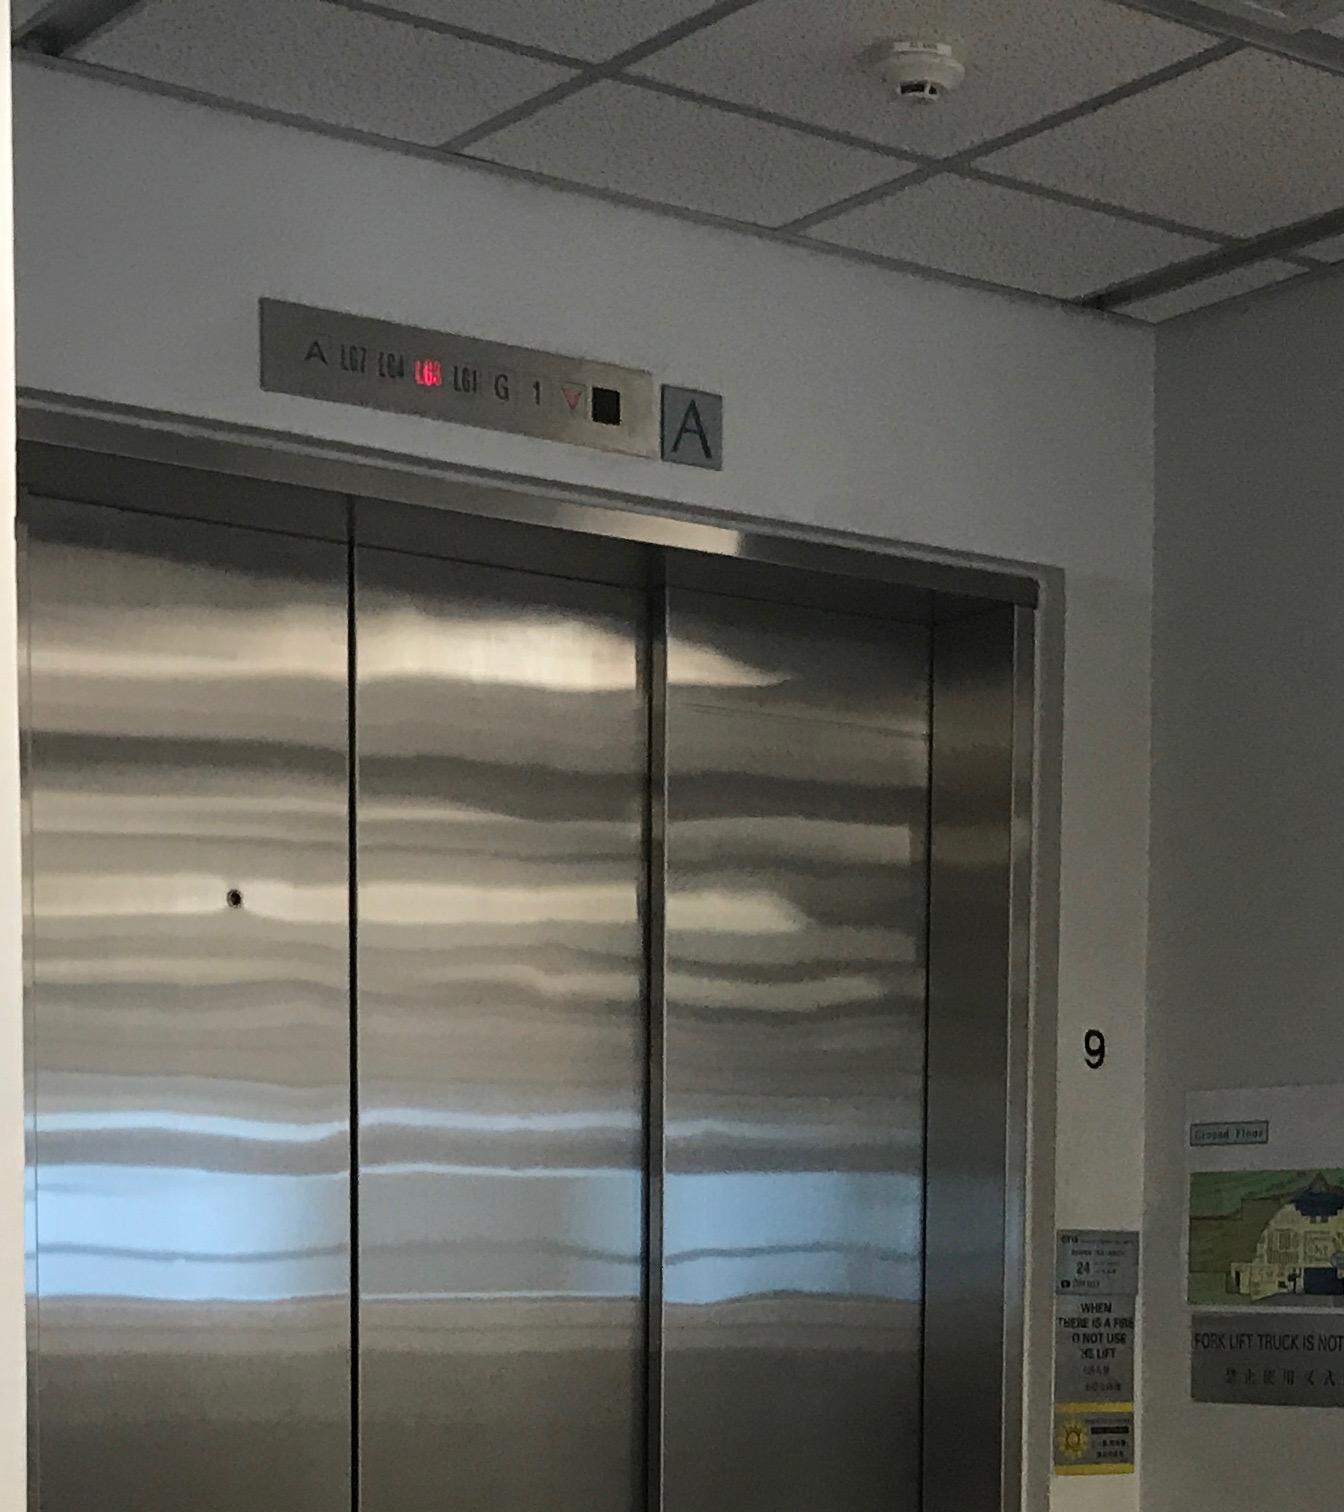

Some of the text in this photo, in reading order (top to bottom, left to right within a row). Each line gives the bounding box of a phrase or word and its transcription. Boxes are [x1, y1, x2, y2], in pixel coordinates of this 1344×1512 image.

[340, 344, 367, 373] LG7
[494, 374, 509, 402] G
[533, 380, 541, 405] 1
[671, 399, 712, 460] A
[1083, 1029, 1106, 1069] 9
[1076, 1261, 1090, 1274] 24
[1081, 1303, 1112, 1313] WHEN
[1058, 1317, 1134, 1329] THERE IS A FIRE
[1082, 1333, 1103, 1344] NOT
[1107, 1333, 1126, 1344] USE
[1195, 1333, 1226, 1349] FORK
[1229, 1333, 1253, 1349] LIFT
[1257, 1333, 1299, 1350] TRUCK
[1302, 1334, 1315, 1351] IS
[1318, 1335, 1344, 1352] NOT
[1096, 1348, 1116, 1359] LIFT
